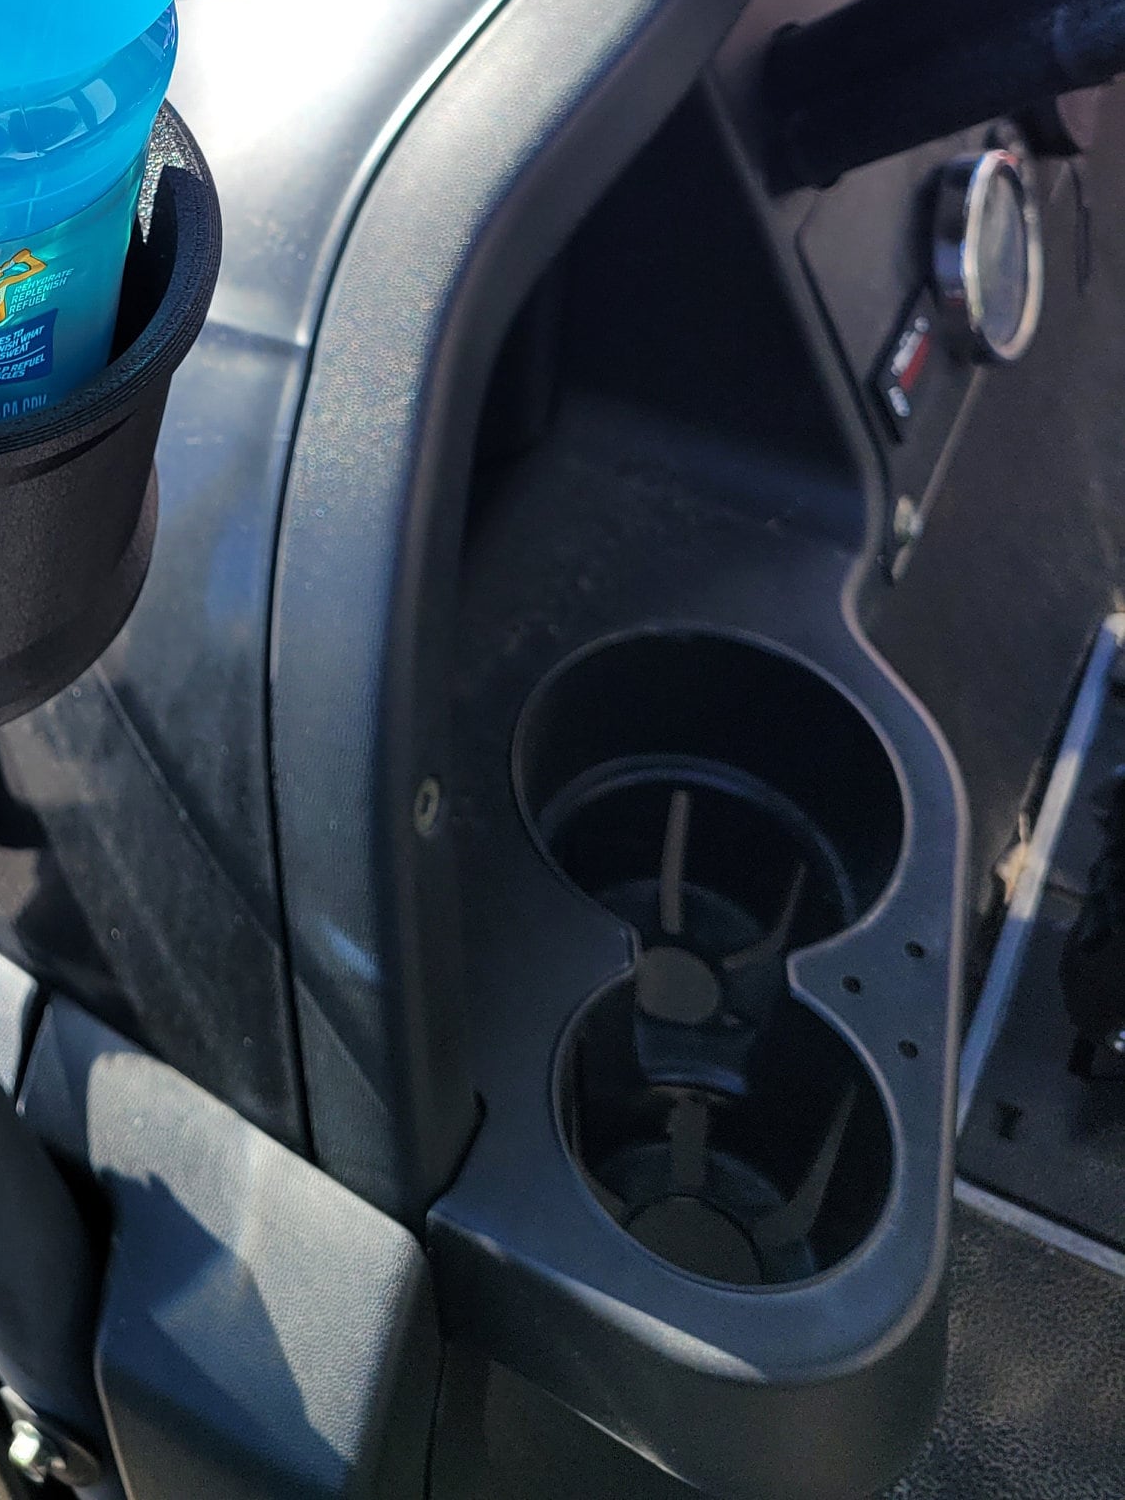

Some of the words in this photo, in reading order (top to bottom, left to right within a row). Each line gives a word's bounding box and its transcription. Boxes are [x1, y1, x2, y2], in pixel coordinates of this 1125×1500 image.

[11, 277, 67, 304] REPLENISH
[14, 268, 74, 294] REHYDRATE
[9, 293, 46, 314] REFUEL
[13, 328, 24, 339] TO
[21, 325, 45, 343] WHAT
[11, 353, 45, 371] REFUEL
